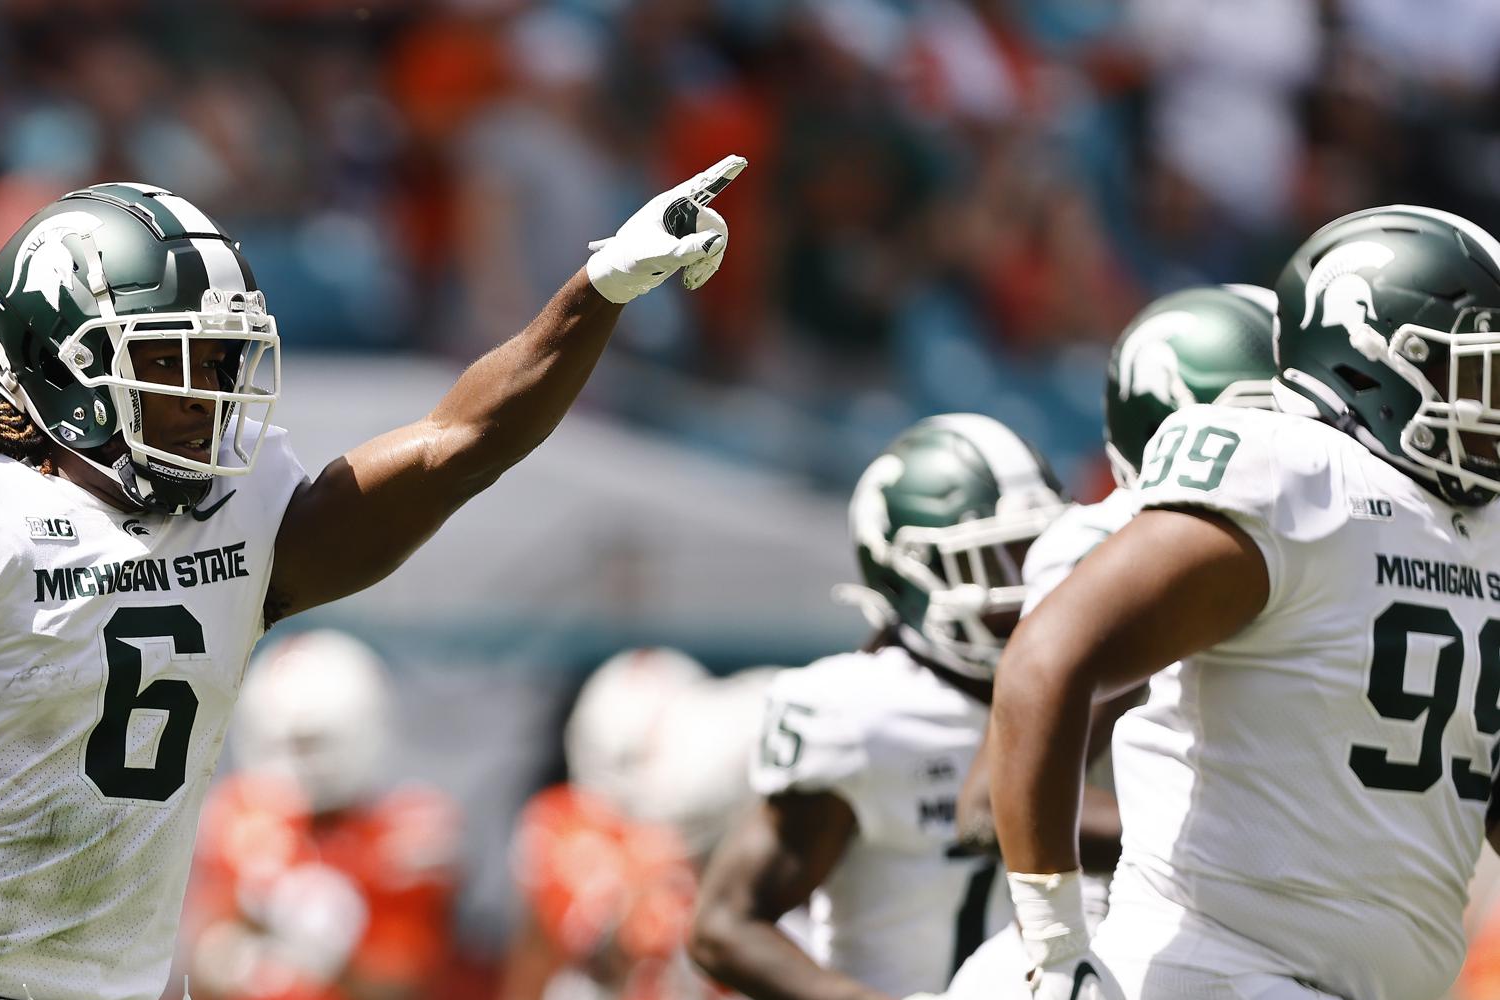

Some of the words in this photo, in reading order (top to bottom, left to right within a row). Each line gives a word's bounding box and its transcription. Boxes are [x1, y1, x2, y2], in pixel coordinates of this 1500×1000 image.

[1141, 424, 1241, 492] 99
[33, 559, 171, 602] MICHIGAN
[173, 541, 250, 588] STATE
[1375, 552, 1484, 600] MICHIGAN
[84, 604, 206, 802] 6
